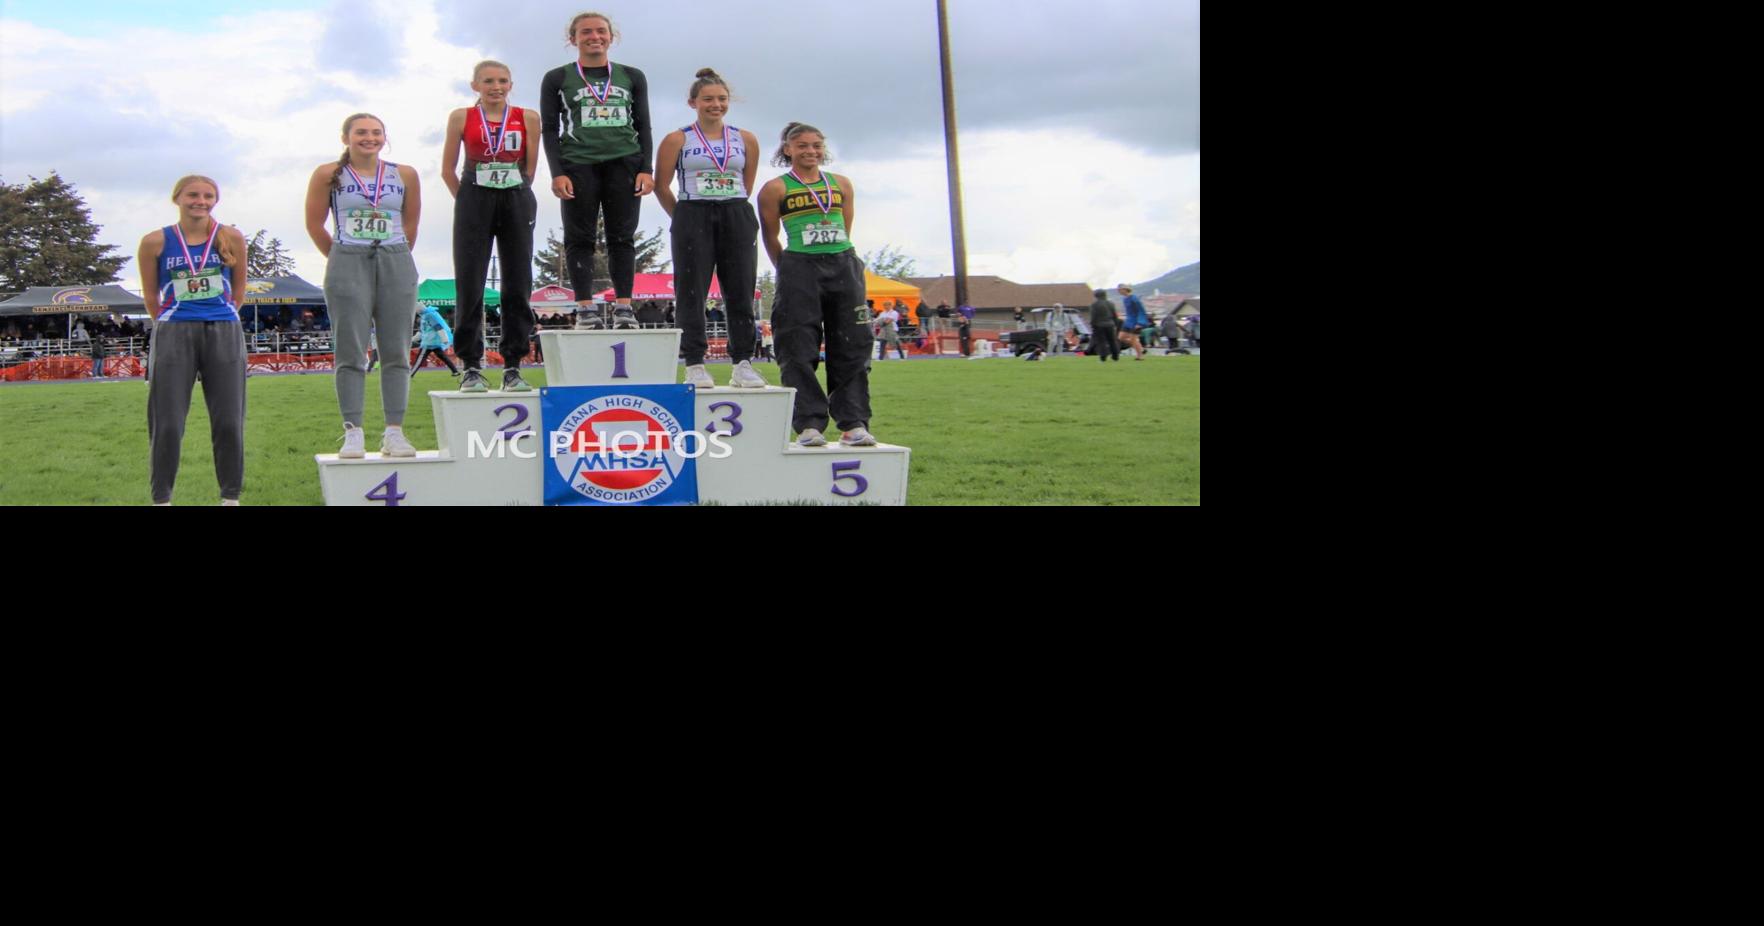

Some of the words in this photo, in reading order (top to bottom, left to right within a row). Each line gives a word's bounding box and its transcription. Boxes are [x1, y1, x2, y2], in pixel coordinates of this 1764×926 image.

[573, 85, 629, 101] JOLET
[507, 131, 516, 150] 1
[684, 146, 745, 158] FOST
[489, 170, 510, 184] 47
[353, 218, 387, 233] 340
[809, 230, 838, 246] 287
[610, 341, 629, 378] 1
[493, 403, 531, 441] 2
[605, 397, 643, 408] HIGH
[650, 406, 682, 451] SCHO
[705, 401, 743, 437] 3
[365, 471, 407, 506] 4
[576, 478, 668, 502] ASSOCIATION
[831, 460, 868, 497] 5
